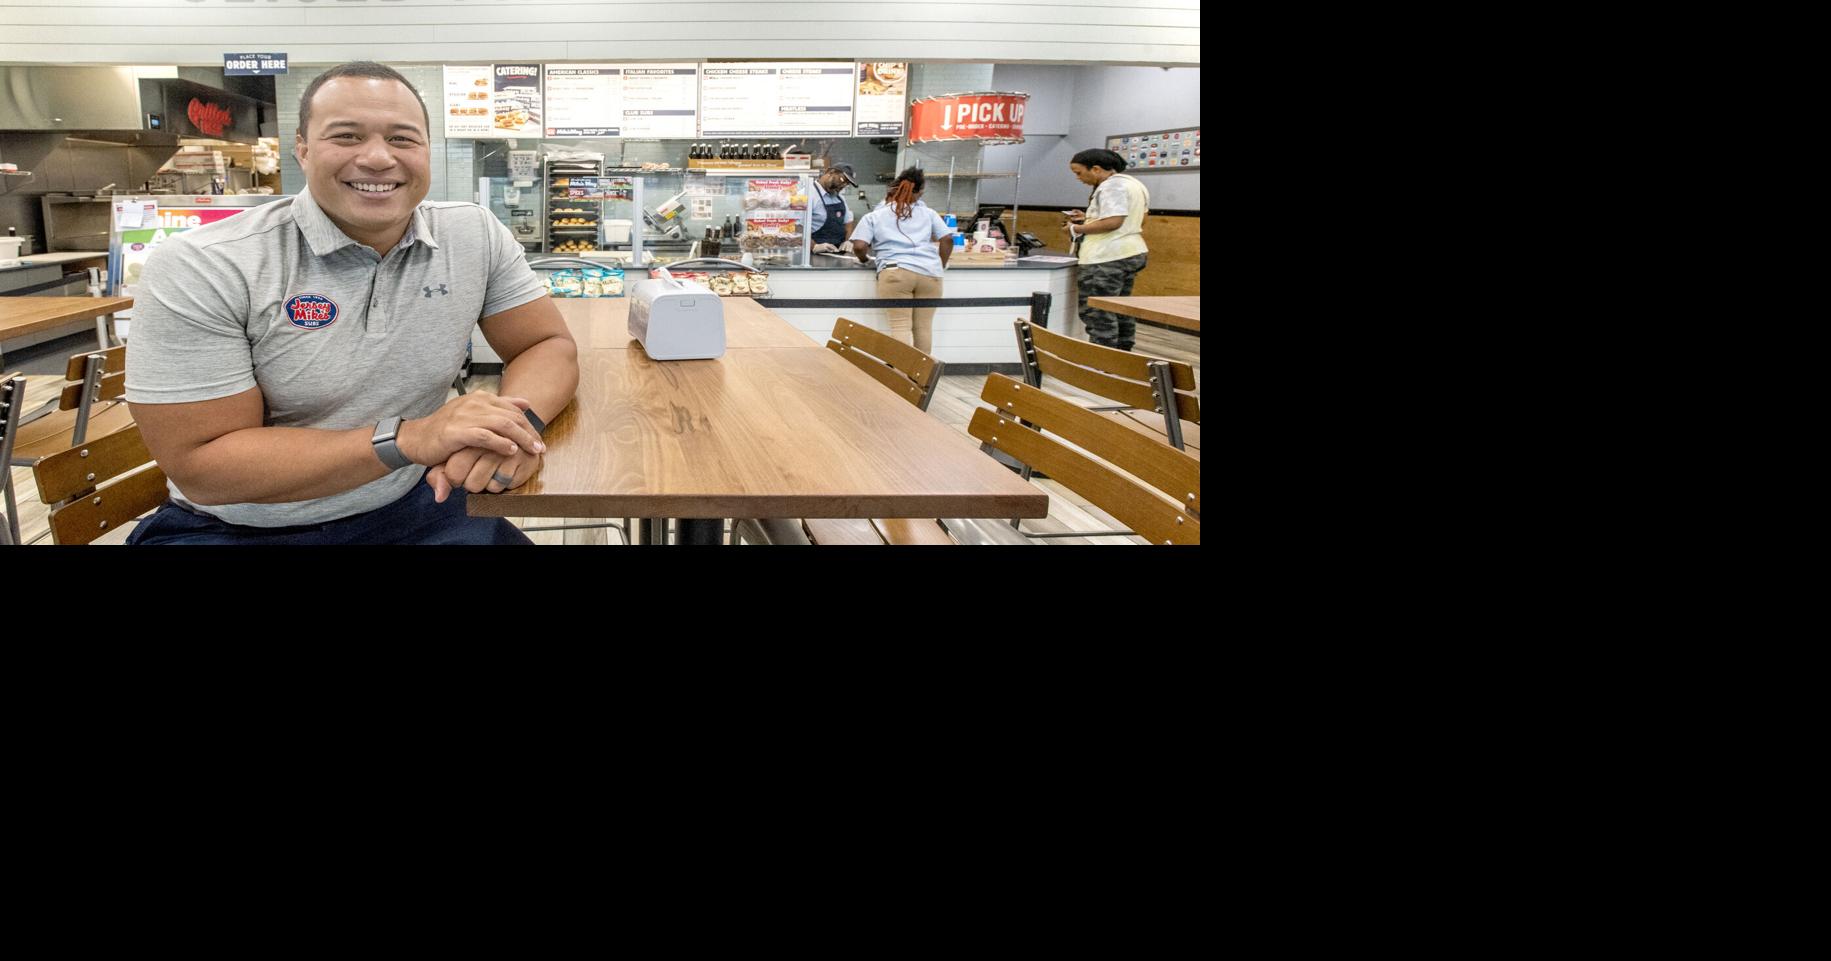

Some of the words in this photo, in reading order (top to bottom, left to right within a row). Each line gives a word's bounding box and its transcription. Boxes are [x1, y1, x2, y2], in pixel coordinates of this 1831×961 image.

[226, 60, 258, 70] ORDER
[260, 60, 286, 70] HERE
[496, 66, 538, 77] CATERING!
[957, 102, 1005, 123] PICK
[1009, 103, 1024, 122] UP
[291, 298, 331, 313] Jersey
